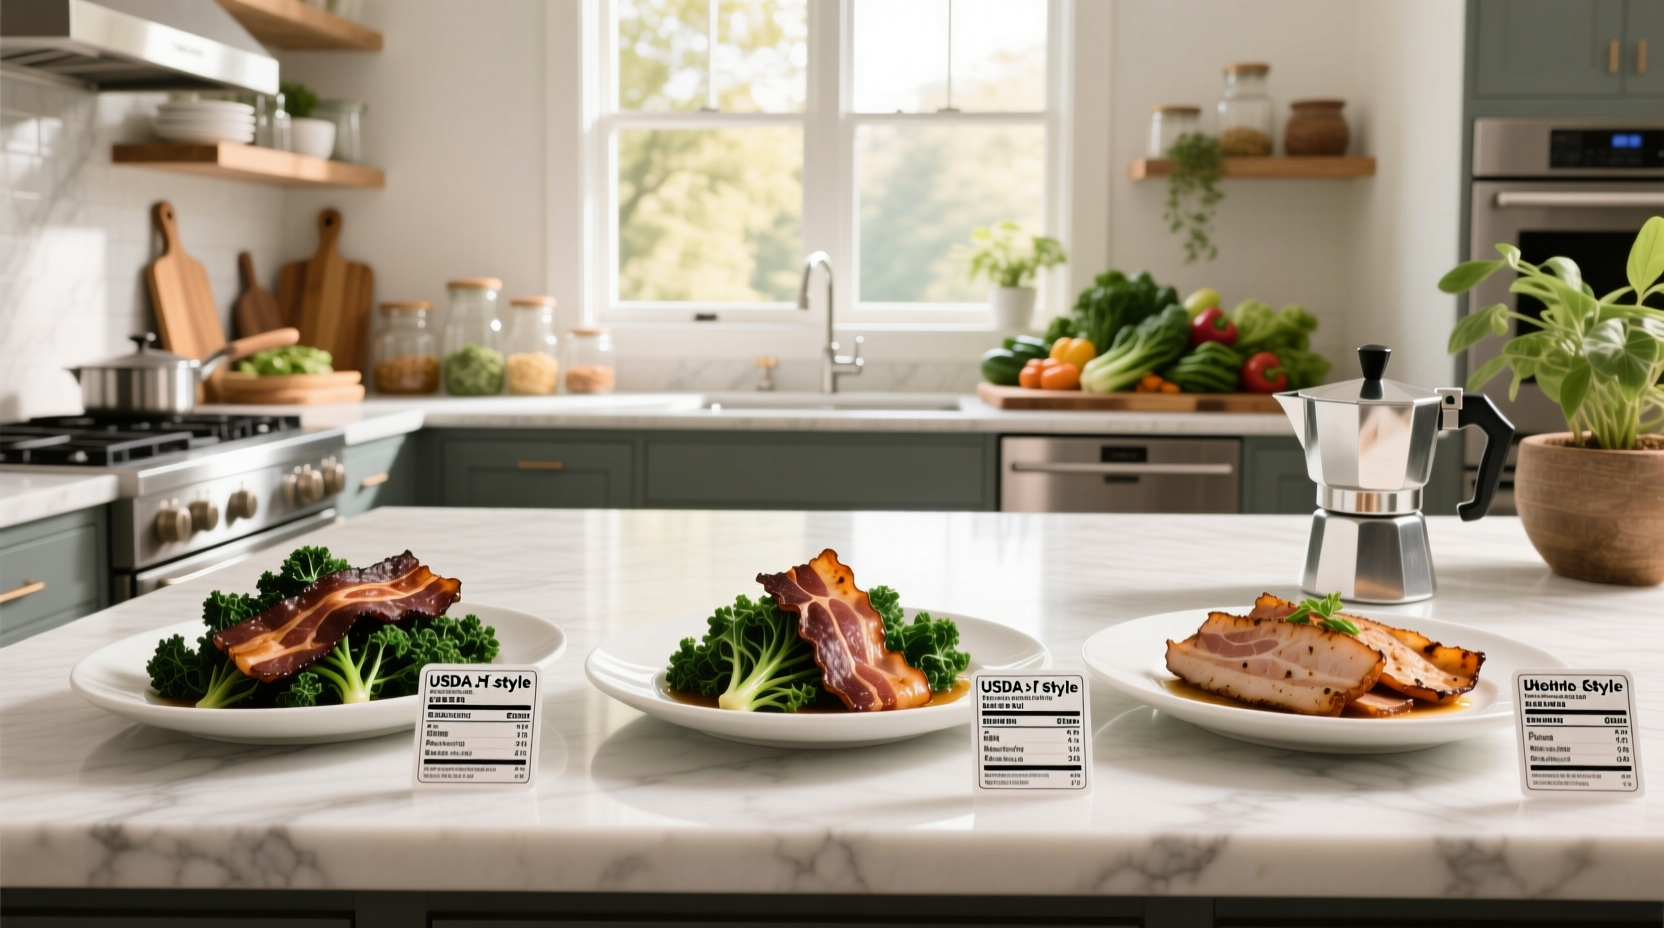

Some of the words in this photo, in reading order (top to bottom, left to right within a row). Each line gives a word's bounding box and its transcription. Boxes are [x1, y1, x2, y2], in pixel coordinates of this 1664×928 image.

[430, 675, 472, 688] USDA
[493, 675, 531, 693] style
[981, 680, 1023, 693] USDA
